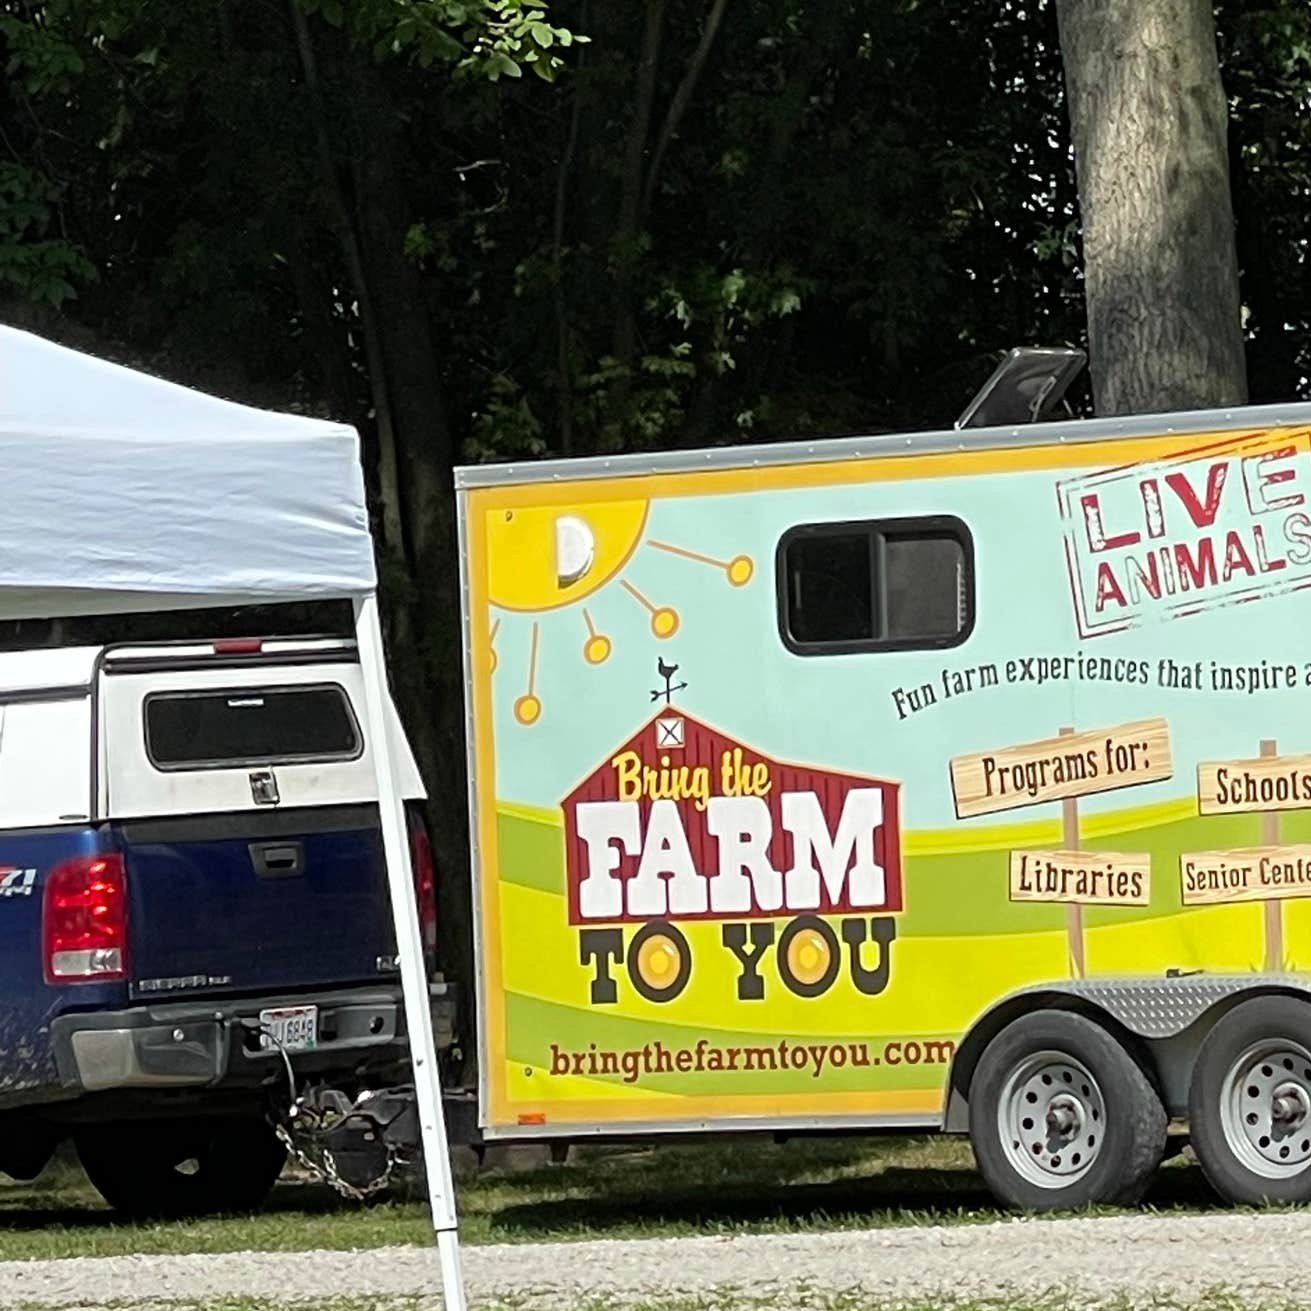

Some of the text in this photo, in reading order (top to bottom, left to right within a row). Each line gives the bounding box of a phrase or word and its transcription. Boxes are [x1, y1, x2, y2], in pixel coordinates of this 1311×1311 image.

[1080, 445, 1305, 553] LIVE
[891, 687, 938, 720] Fun
[941, 662, 999, 698] farm
[1006, 651, 1149, 684] experiences
[1158, 659, 1202, 690] that
[1211, 659, 1297, 694] inspire
[612, 748, 772, 812] Bring the
[982, 739, 1150, 798] Programs for:
[575, 787, 886, 918] FARM
[1018, 855, 1143, 898] Libraries
[1185, 861, 1252, 891] Senior
[579, 911, 897, 1004] TO YOU
[550, 1039, 955, 1083] bringthefarmtoyou.com
